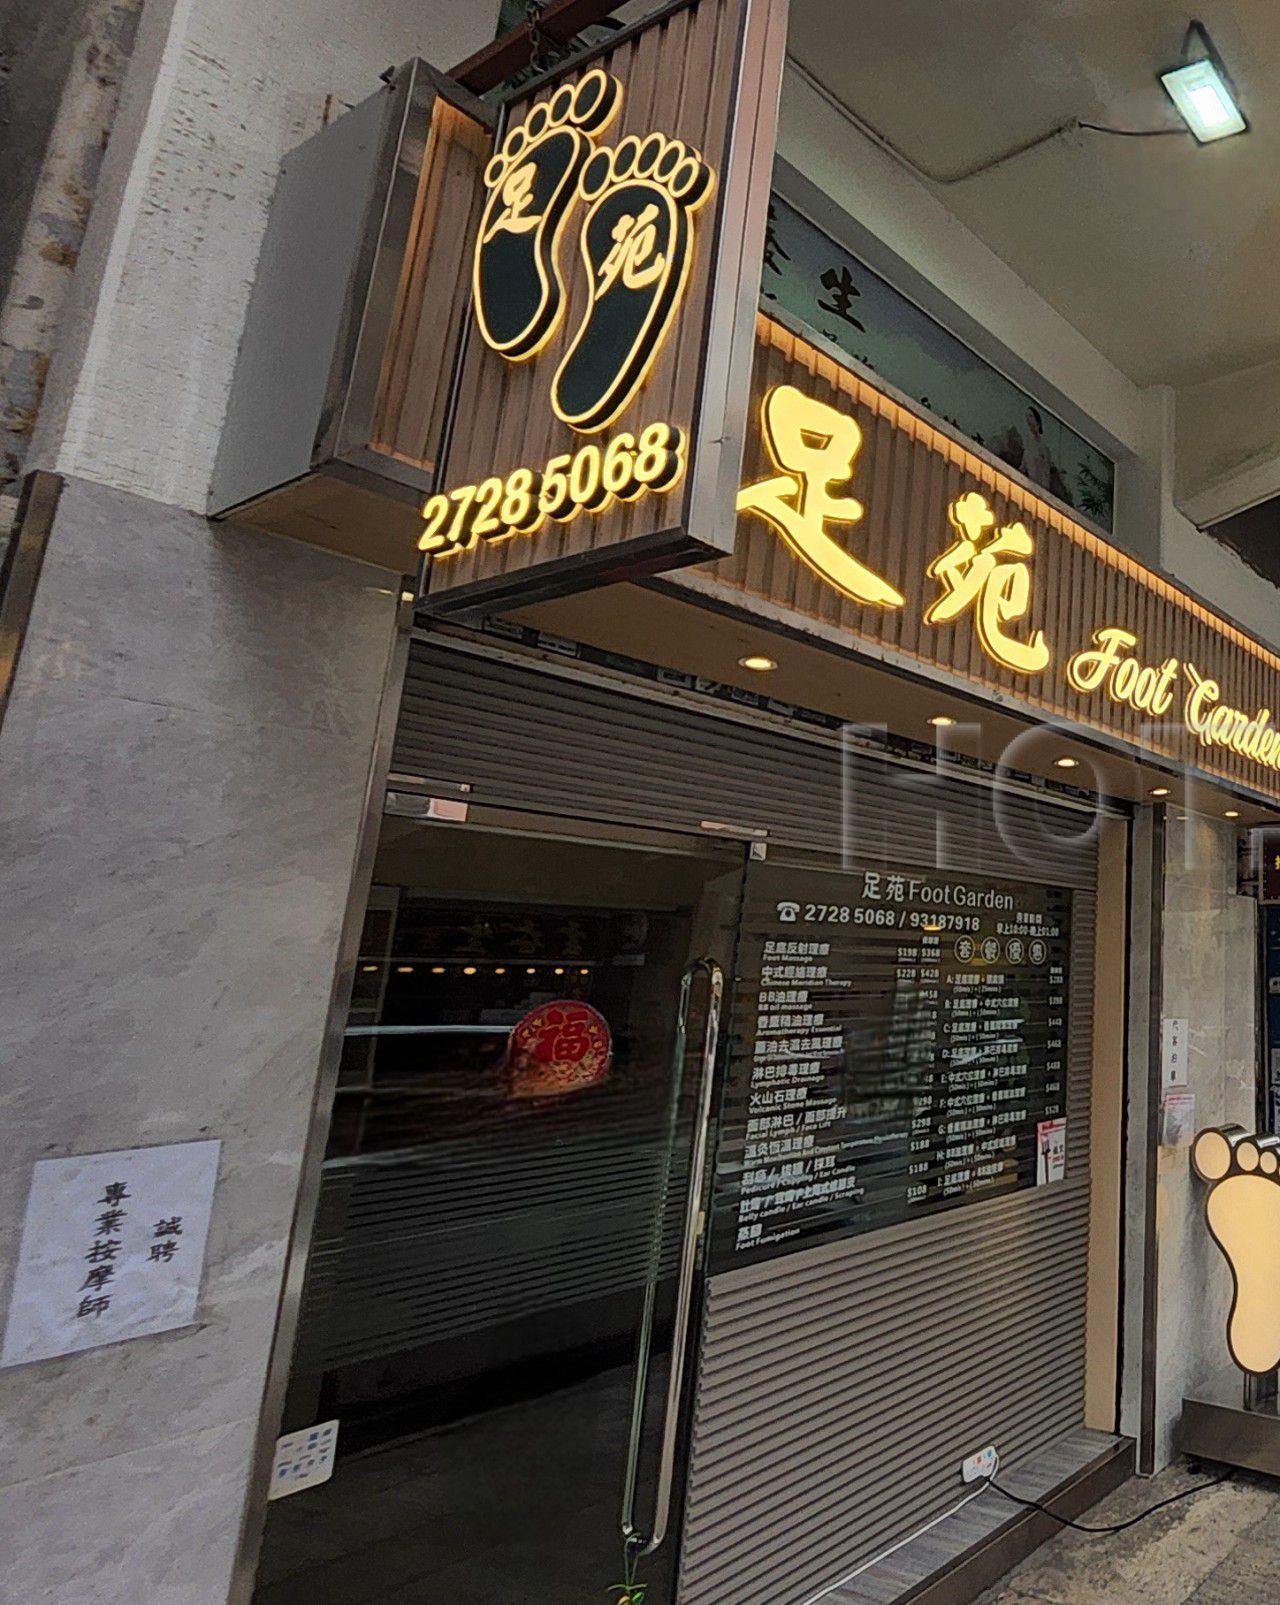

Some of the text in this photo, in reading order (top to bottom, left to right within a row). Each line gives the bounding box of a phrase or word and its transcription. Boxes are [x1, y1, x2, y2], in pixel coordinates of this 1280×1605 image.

[484, 160, 668, 301] 足 苑
[736, 384, 1051, 673] 足苑
[1067, 628, 1180, 716] Foot
[804, 904, 850, 923] 2728
[854, 908, 896, 926] 5068
[910, 912, 980, 931] 93187918
[861, 871, 1014, 911] 足苑 Foot Garden
[535, 1008, 592, 1064] 福
[75, 1181, 132, 1321] 專業按摩師
[146, 1215, 184, 1264] 誠聘
